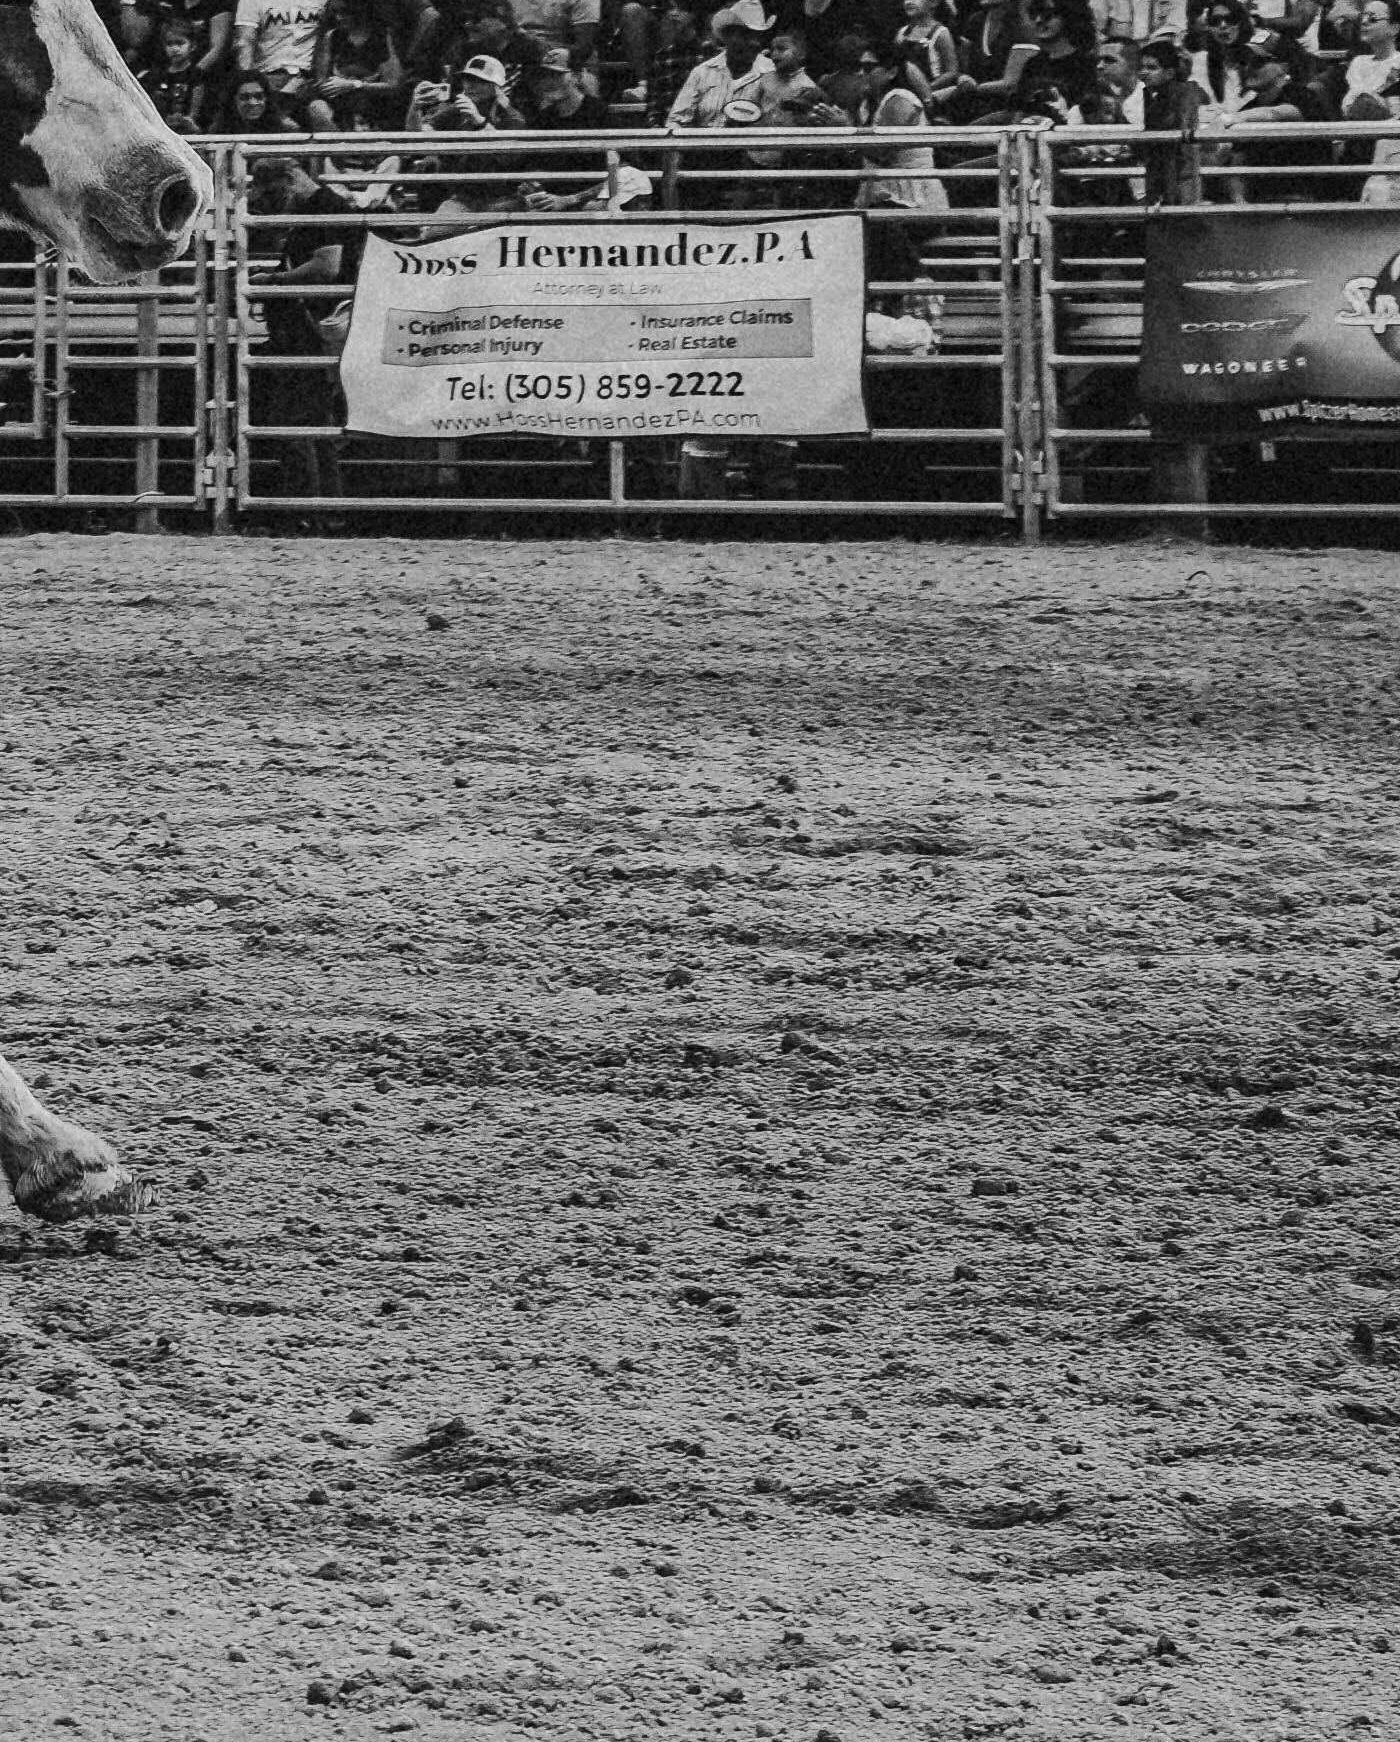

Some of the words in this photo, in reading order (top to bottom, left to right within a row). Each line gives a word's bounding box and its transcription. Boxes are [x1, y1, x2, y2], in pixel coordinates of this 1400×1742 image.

[265, 9, 321, 26] MIAM
[532, 282, 605, 299] Attorney
[608, 283, 625, 295] at
[630, 282, 663, 295] Law
[408, 316, 486, 336] Criminal
[489, 315, 565, 330] Defense
[641, 315, 725, 330] Insurance
[729, 309, 795, 326] Claims
[408, 338, 486, 358] Personal
[489, 337, 544, 356] Injury
[638, 336, 676, 352] Real
[681, 335, 739, 350] Estate
[446, 373, 495, 402] Tel:
[504, 373, 586, 404] (305)
[596, 370, 746, 400] 859-2222
[431, 408, 761, 431] www.HossHernandezPA.com
